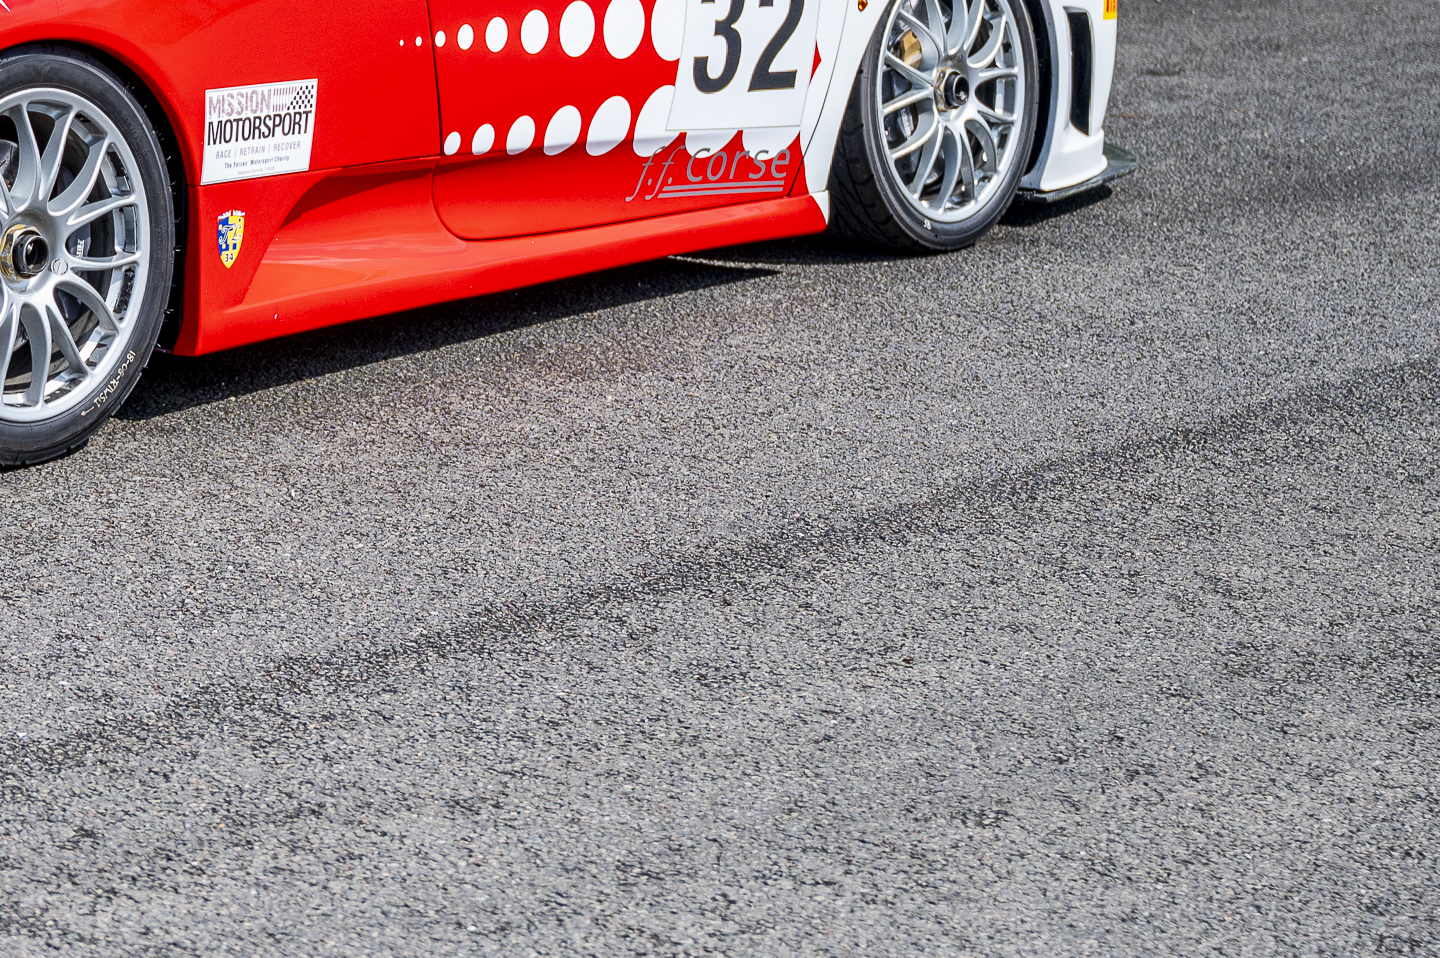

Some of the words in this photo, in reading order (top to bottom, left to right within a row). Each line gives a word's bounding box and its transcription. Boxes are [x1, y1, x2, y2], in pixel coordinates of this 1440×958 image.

[208, 88, 272, 119] MISSION
[207, 109, 313, 146] MOTORSPORT
[215, 149, 232, 160] RACE
[239, 145, 266, 156] RETRAIN
[273, 140, 301, 152] RECOVER
